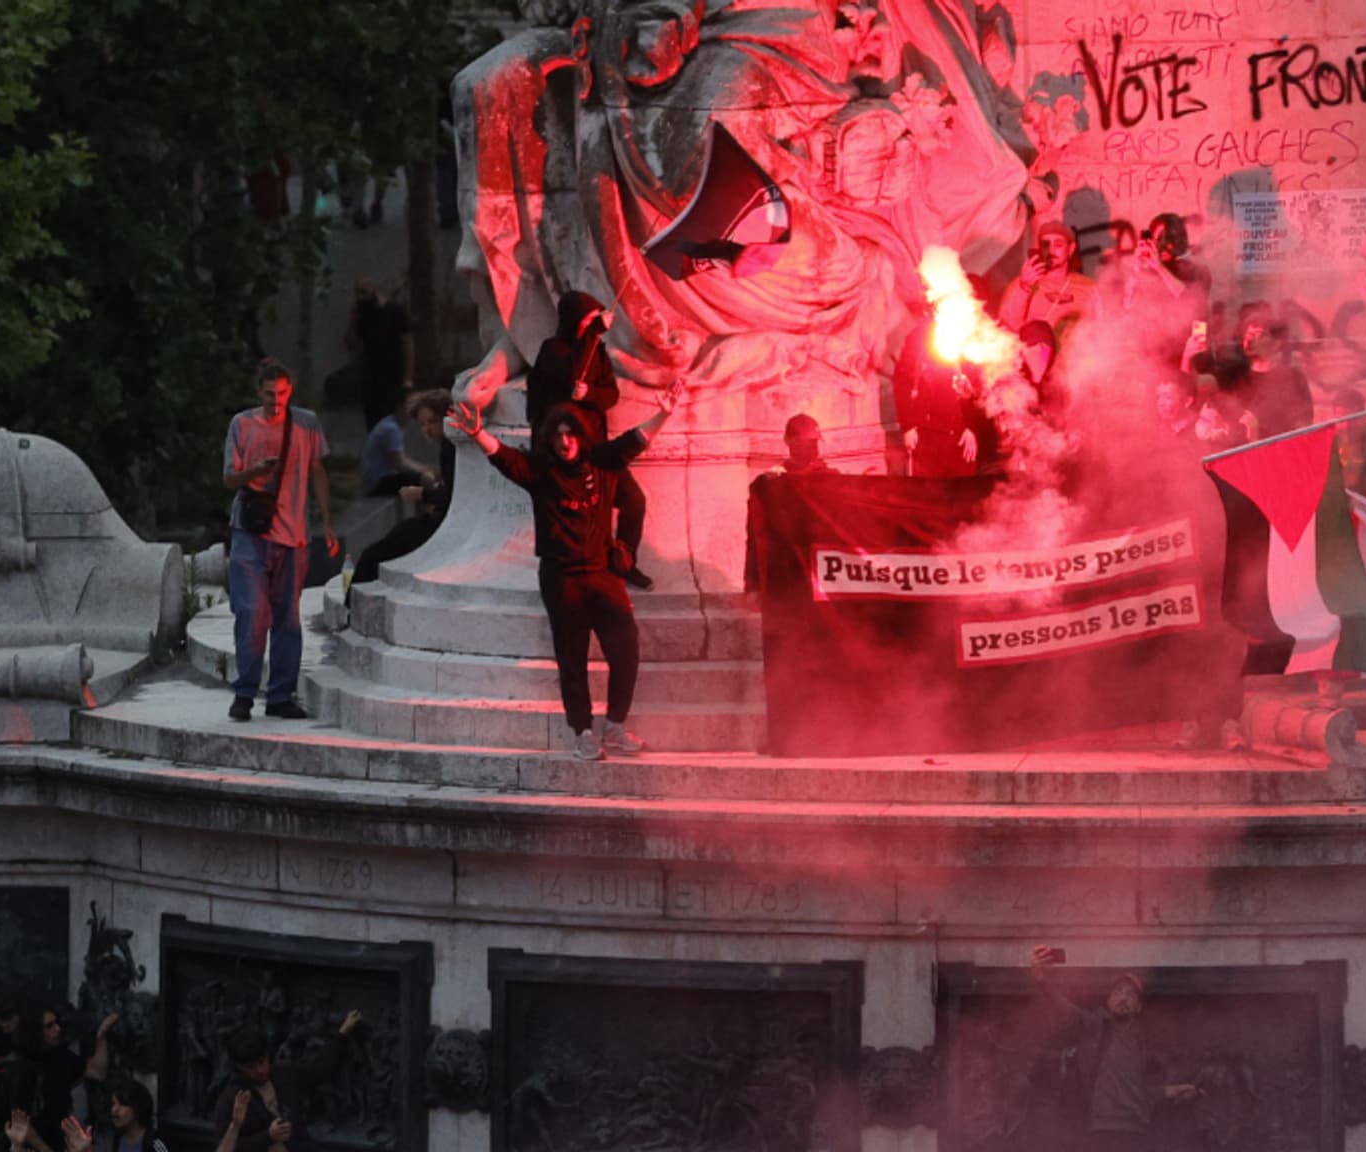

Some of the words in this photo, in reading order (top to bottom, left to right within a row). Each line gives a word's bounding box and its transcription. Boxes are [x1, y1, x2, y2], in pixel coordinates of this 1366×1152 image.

[1078, 34, 1208, 131] VOTE
[1103, 128, 1180, 160] PARIS
[1194, 120, 1359, 175] GAUCHES
[822, 554, 949, 591] Puisque
[958, 560, 987, 583] le
[995, 554, 1088, 585] temps
[1095, 529, 1187, 576] presse
[968, 614, 1102, 657] pressons
[1109, 605, 1138, 631] le
[1145, 593, 1195, 628] pas
